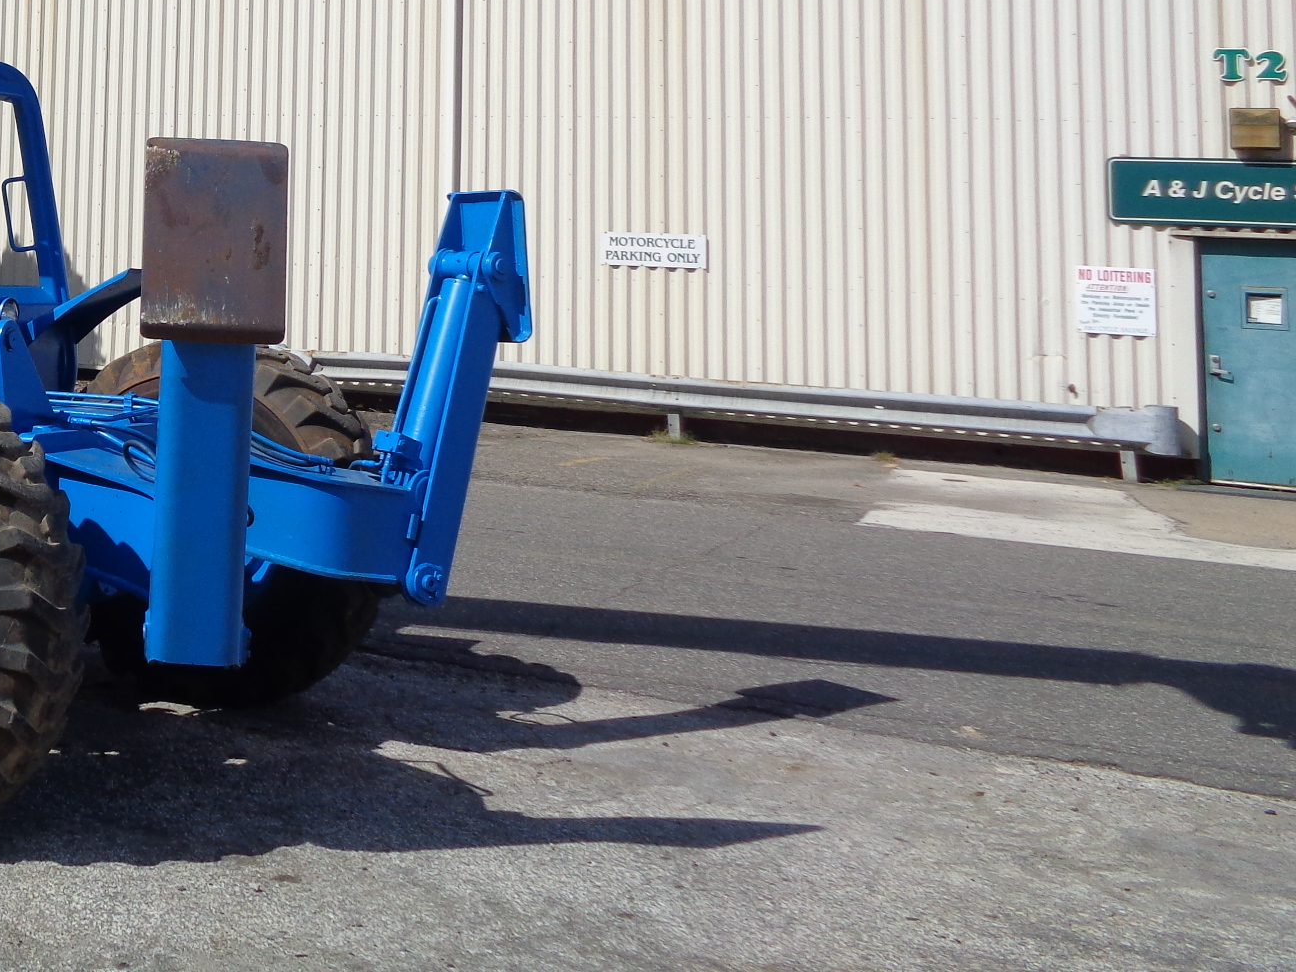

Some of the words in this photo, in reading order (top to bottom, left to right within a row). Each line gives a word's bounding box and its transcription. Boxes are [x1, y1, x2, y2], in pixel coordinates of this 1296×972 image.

[1213, 47, 1288, 82] T2
[1141, 179, 1162, 197] A
[1167, 180, 1186, 199] &
[1192, 181, 1209, 199] J
[1215, 181, 1286, 204] Cycle
[609, 236, 696, 249] MOTORCYCLE
[605, 250, 662, 262] PARKING
[667, 252, 701, 264] ONLY
[1078, 269, 1093, 281] NO
[1097, 270, 1152, 284] LOITERING
